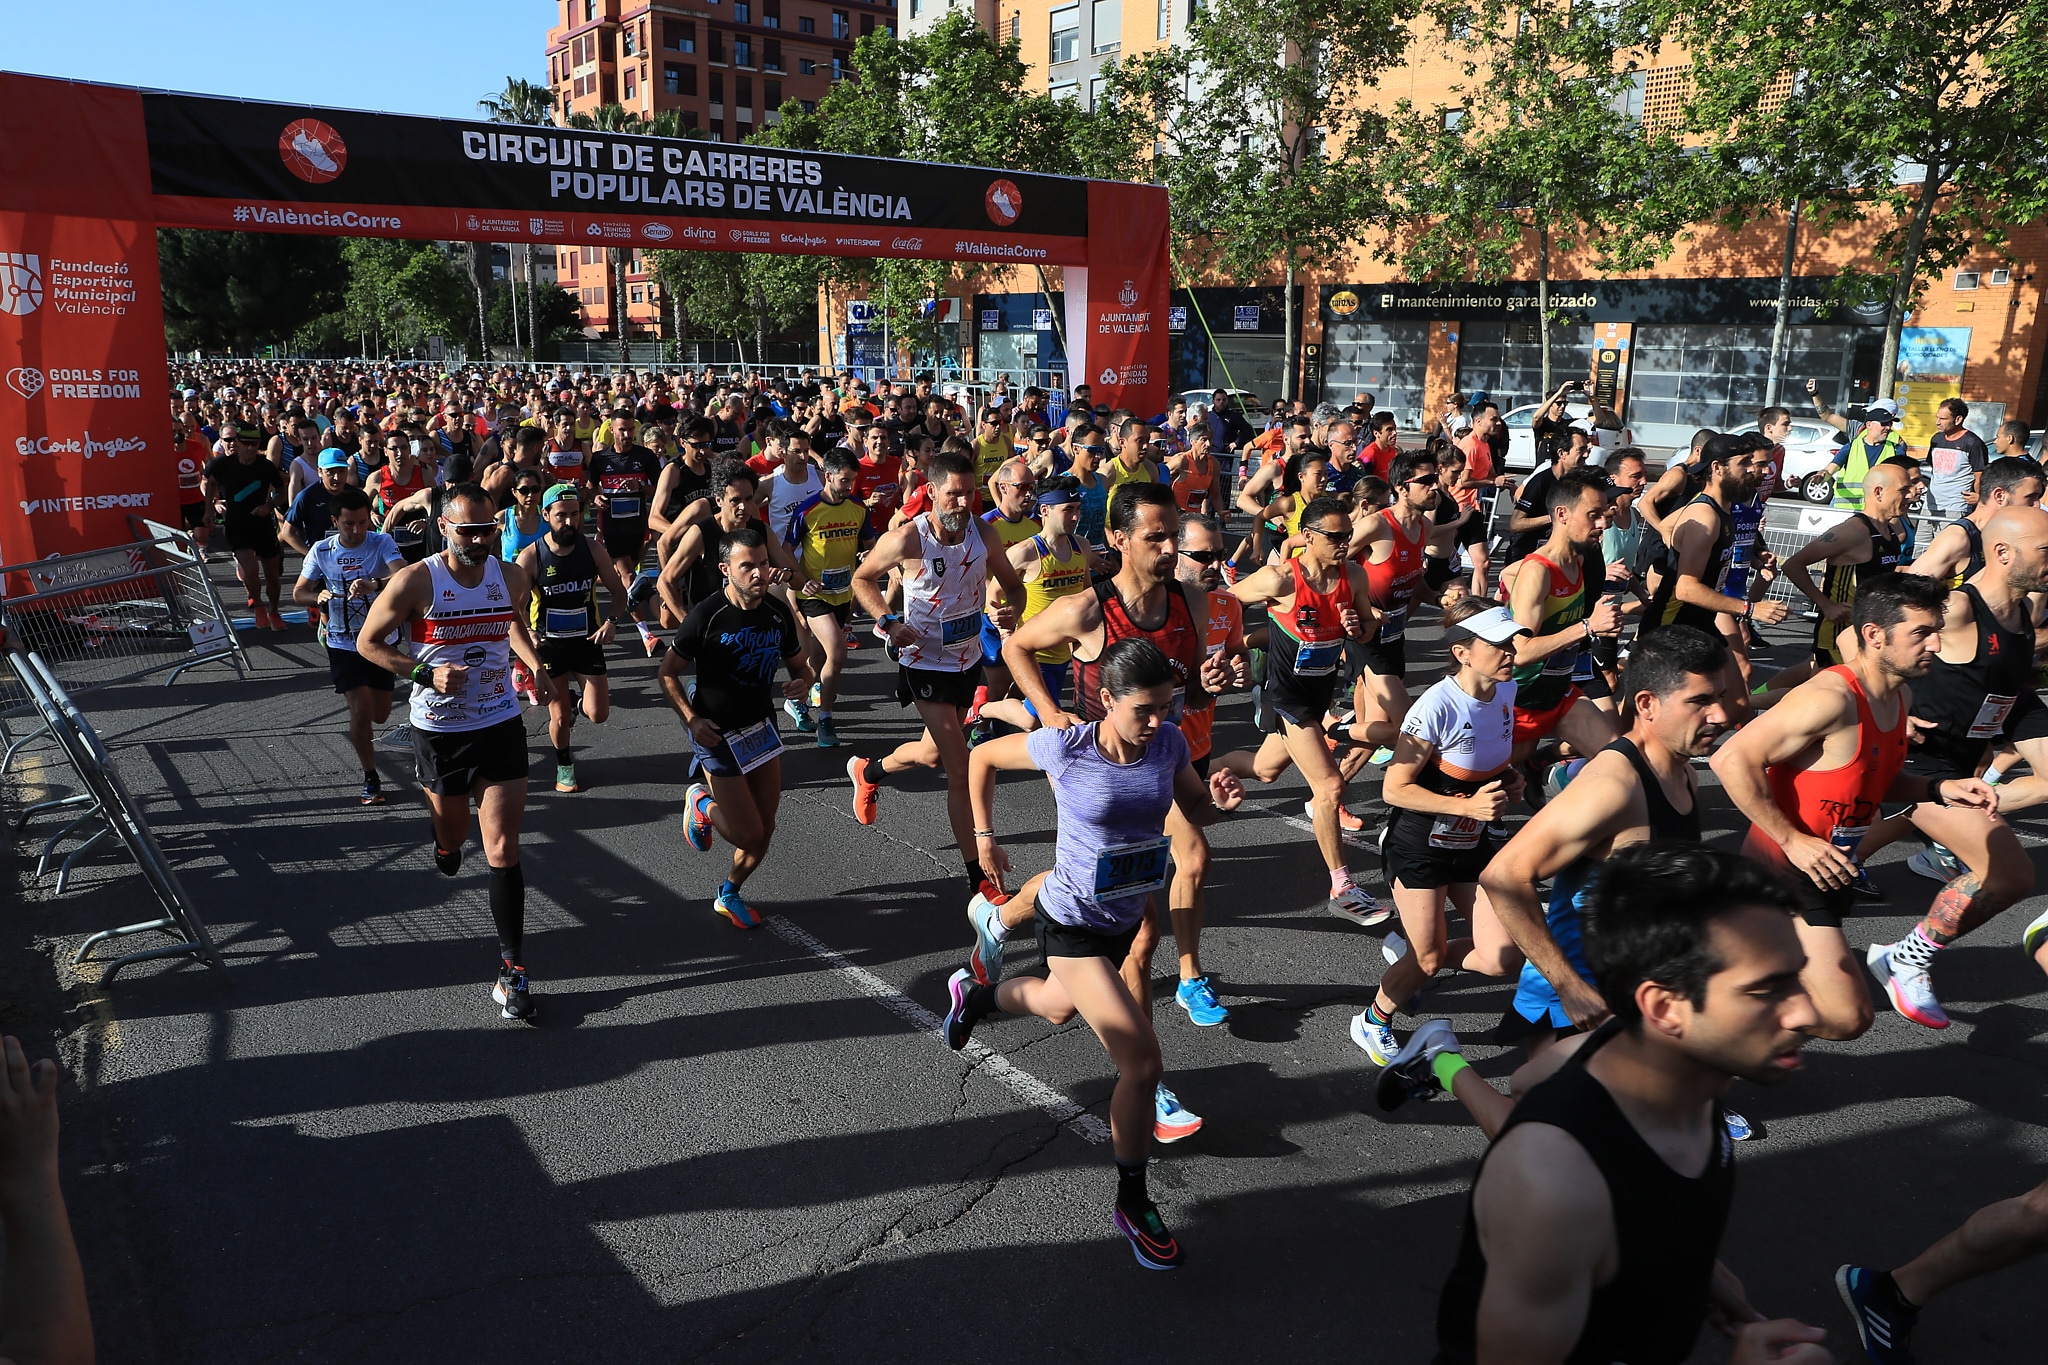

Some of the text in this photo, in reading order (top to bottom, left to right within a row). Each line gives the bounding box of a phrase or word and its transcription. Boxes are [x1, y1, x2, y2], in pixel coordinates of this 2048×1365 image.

[462, 130, 822, 186] CIRCUIT DE CARRERES
[550, 171, 912, 220] POPULARS DE VALÈNCIA
[233, 205, 402, 229] #ValènciaCorre
[646, 227, 671, 236] Serrano
[683, 226, 716, 239] divina
[743, 236, 770, 244] FREEDOM
[843, 238, 881, 247] INTERSPORT
[955, 240, 1047, 258] #ValènciaCorre
[50, 259, 129, 275] Fundació
[52, 273, 133, 289] Esportiva
[54, 288, 136, 303] Municipal
[1381, 294, 1394, 308] El
[1397, 294, 1502, 308] mantenimiento
[54, 301, 126, 316] València
[1100, 312, 1151, 322] AJUNTAMENT
[1099, 322, 1150, 333] DE VALÈNCIA
[50, 368, 139, 382] GOALS FOR
[1119, 377, 1147, 386] ALFONSO
[1120, 370, 1147, 378] TRINIDAD
[52, 384, 141, 399] FREEDOM
[16, 430, 147, 459] El Corte Inglés
[42, 493, 151, 513] INTERSPORT
[819, 527, 859, 540] runners
[543, 578, 593, 597] REDOLAT
[1042, 574, 1085, 588] runners
[734, 625, 782, 653] STRONG
[1107, 851, 1157, 879] 2073
